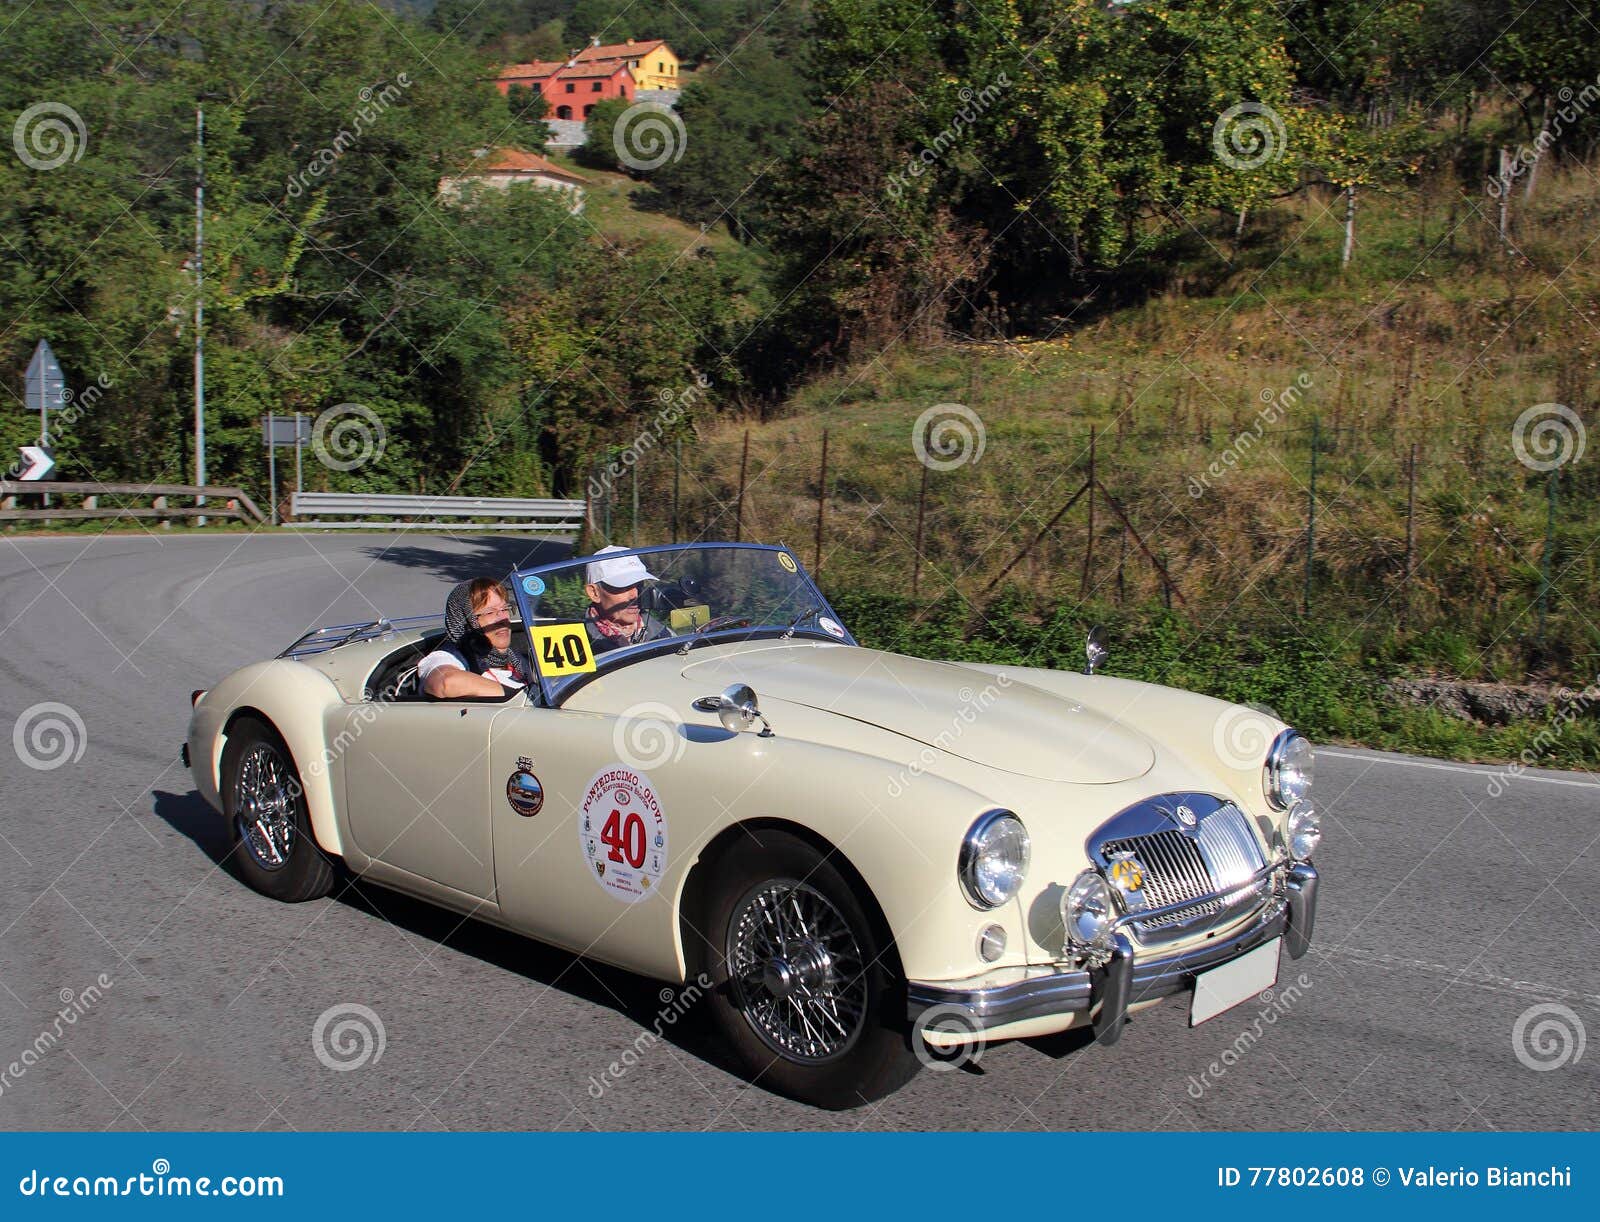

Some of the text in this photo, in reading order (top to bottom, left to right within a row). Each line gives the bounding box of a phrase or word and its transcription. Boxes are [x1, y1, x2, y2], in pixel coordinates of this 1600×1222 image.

[543, 634, 588, 669] 40
[583, 770, 639, 813] PONTEDECIMO
[643, 788, 663, 824] GIOVI
[600, 809, 647, 869] 40
